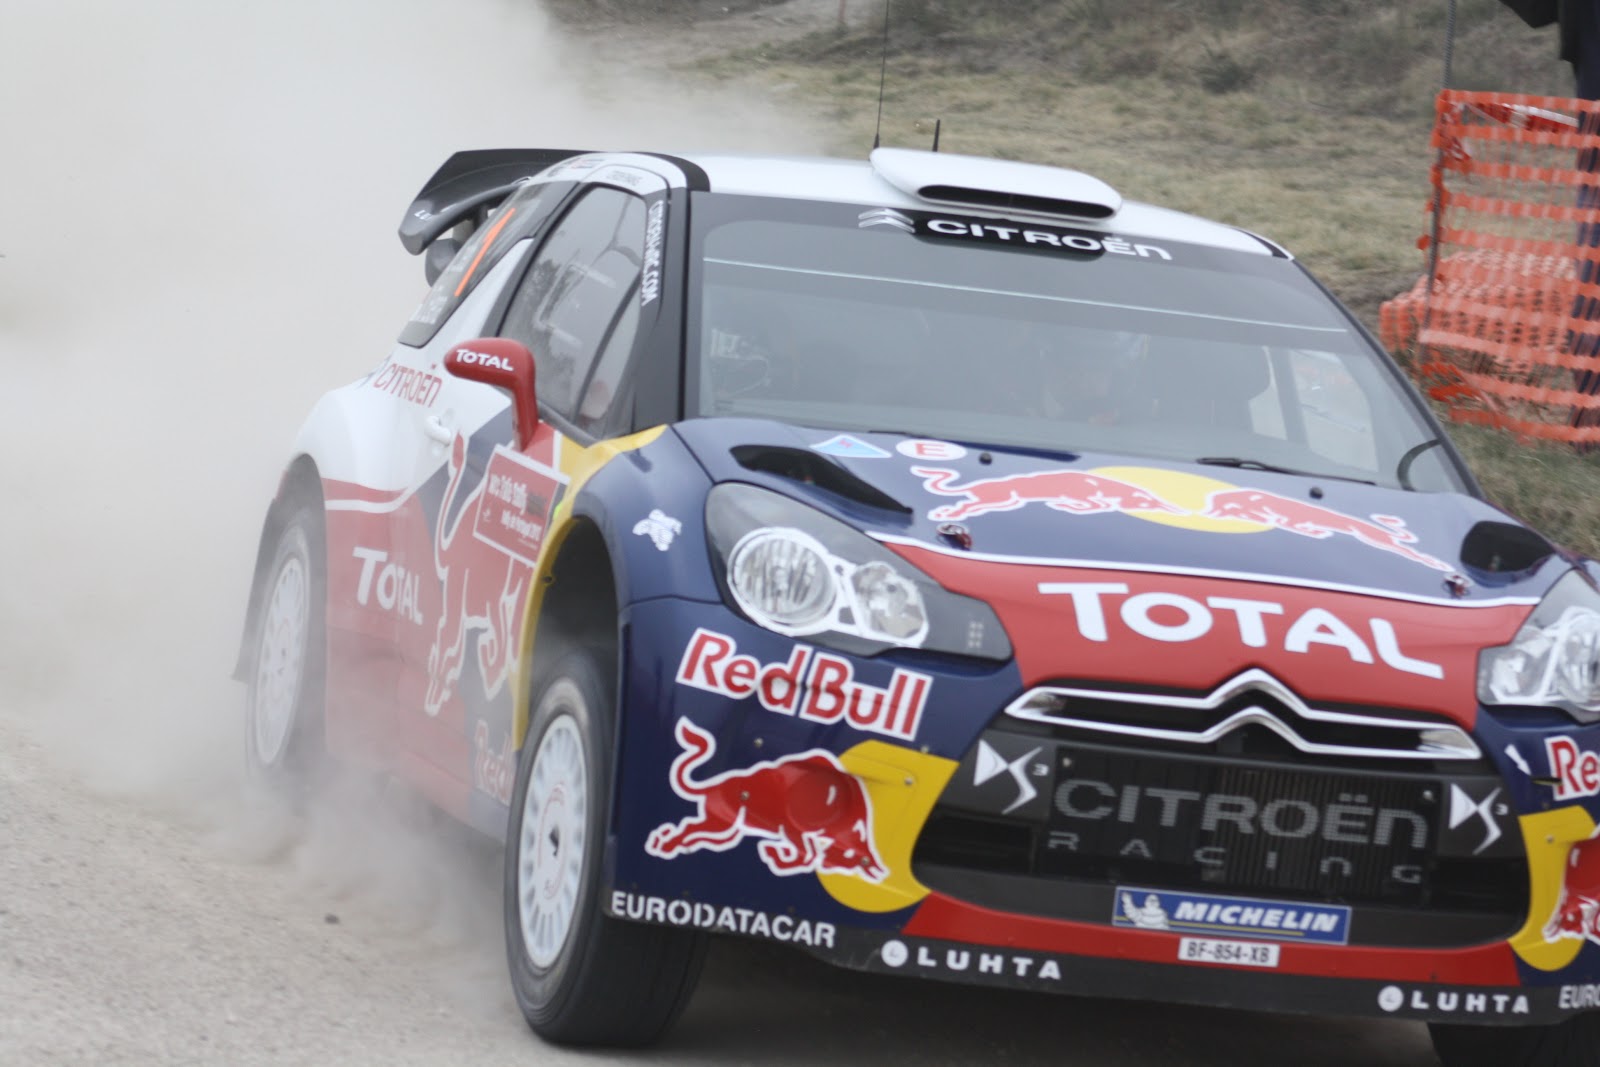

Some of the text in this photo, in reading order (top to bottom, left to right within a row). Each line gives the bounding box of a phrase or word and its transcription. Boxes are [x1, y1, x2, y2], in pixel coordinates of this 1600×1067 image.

[455, 348, 514, 371] TOTAL
[914, 442, 949, 458] E
[352, 546, 424, 626] TOTAL
[1037, 582, 1445, 680] TOTAL
[610, 890, 836, 948] EURODATACAR
[1174, 901, 1340, 933] MICHELIN
[917, 946, 1062, 980] LUHTA
[1186, 940, 1271, 964] BF-854-XB
[1410, 990, 1530, 1014] LUHTA
